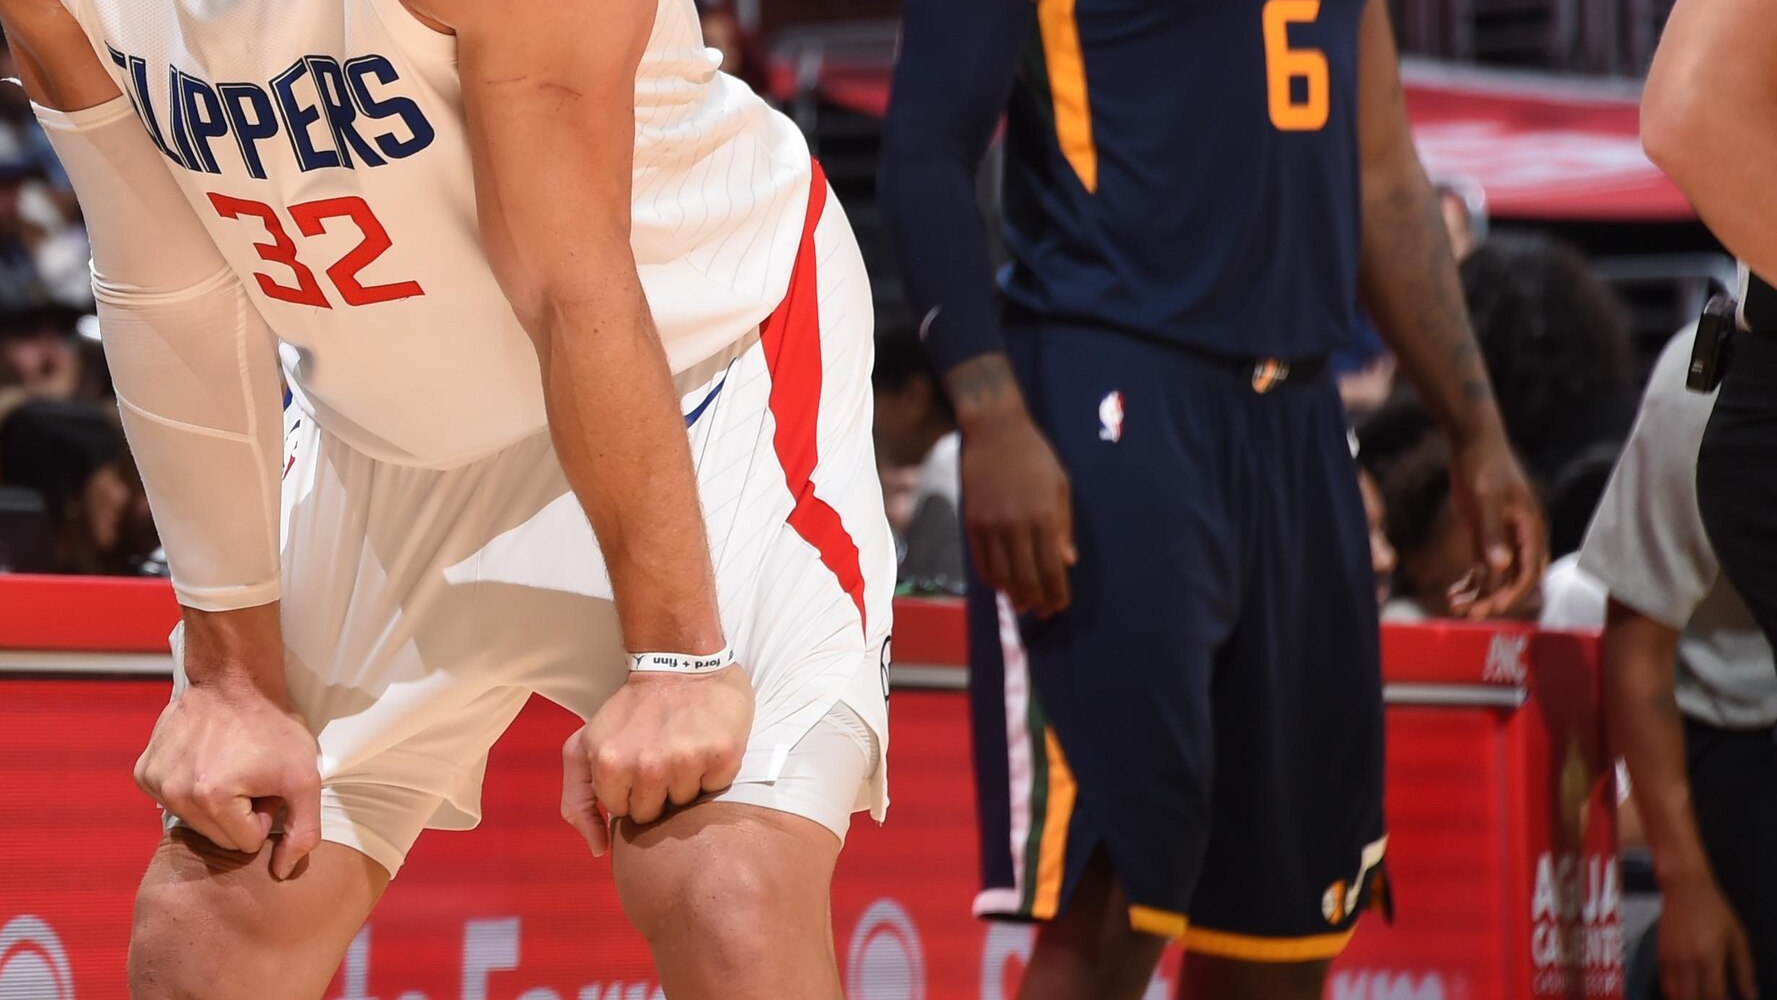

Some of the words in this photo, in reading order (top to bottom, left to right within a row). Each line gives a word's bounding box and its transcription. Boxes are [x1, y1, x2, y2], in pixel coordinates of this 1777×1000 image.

[105, 41, 435, 180] LIPPERS
[206, 191, 426, 310] 32
[653, 656, 678, 668] finn
